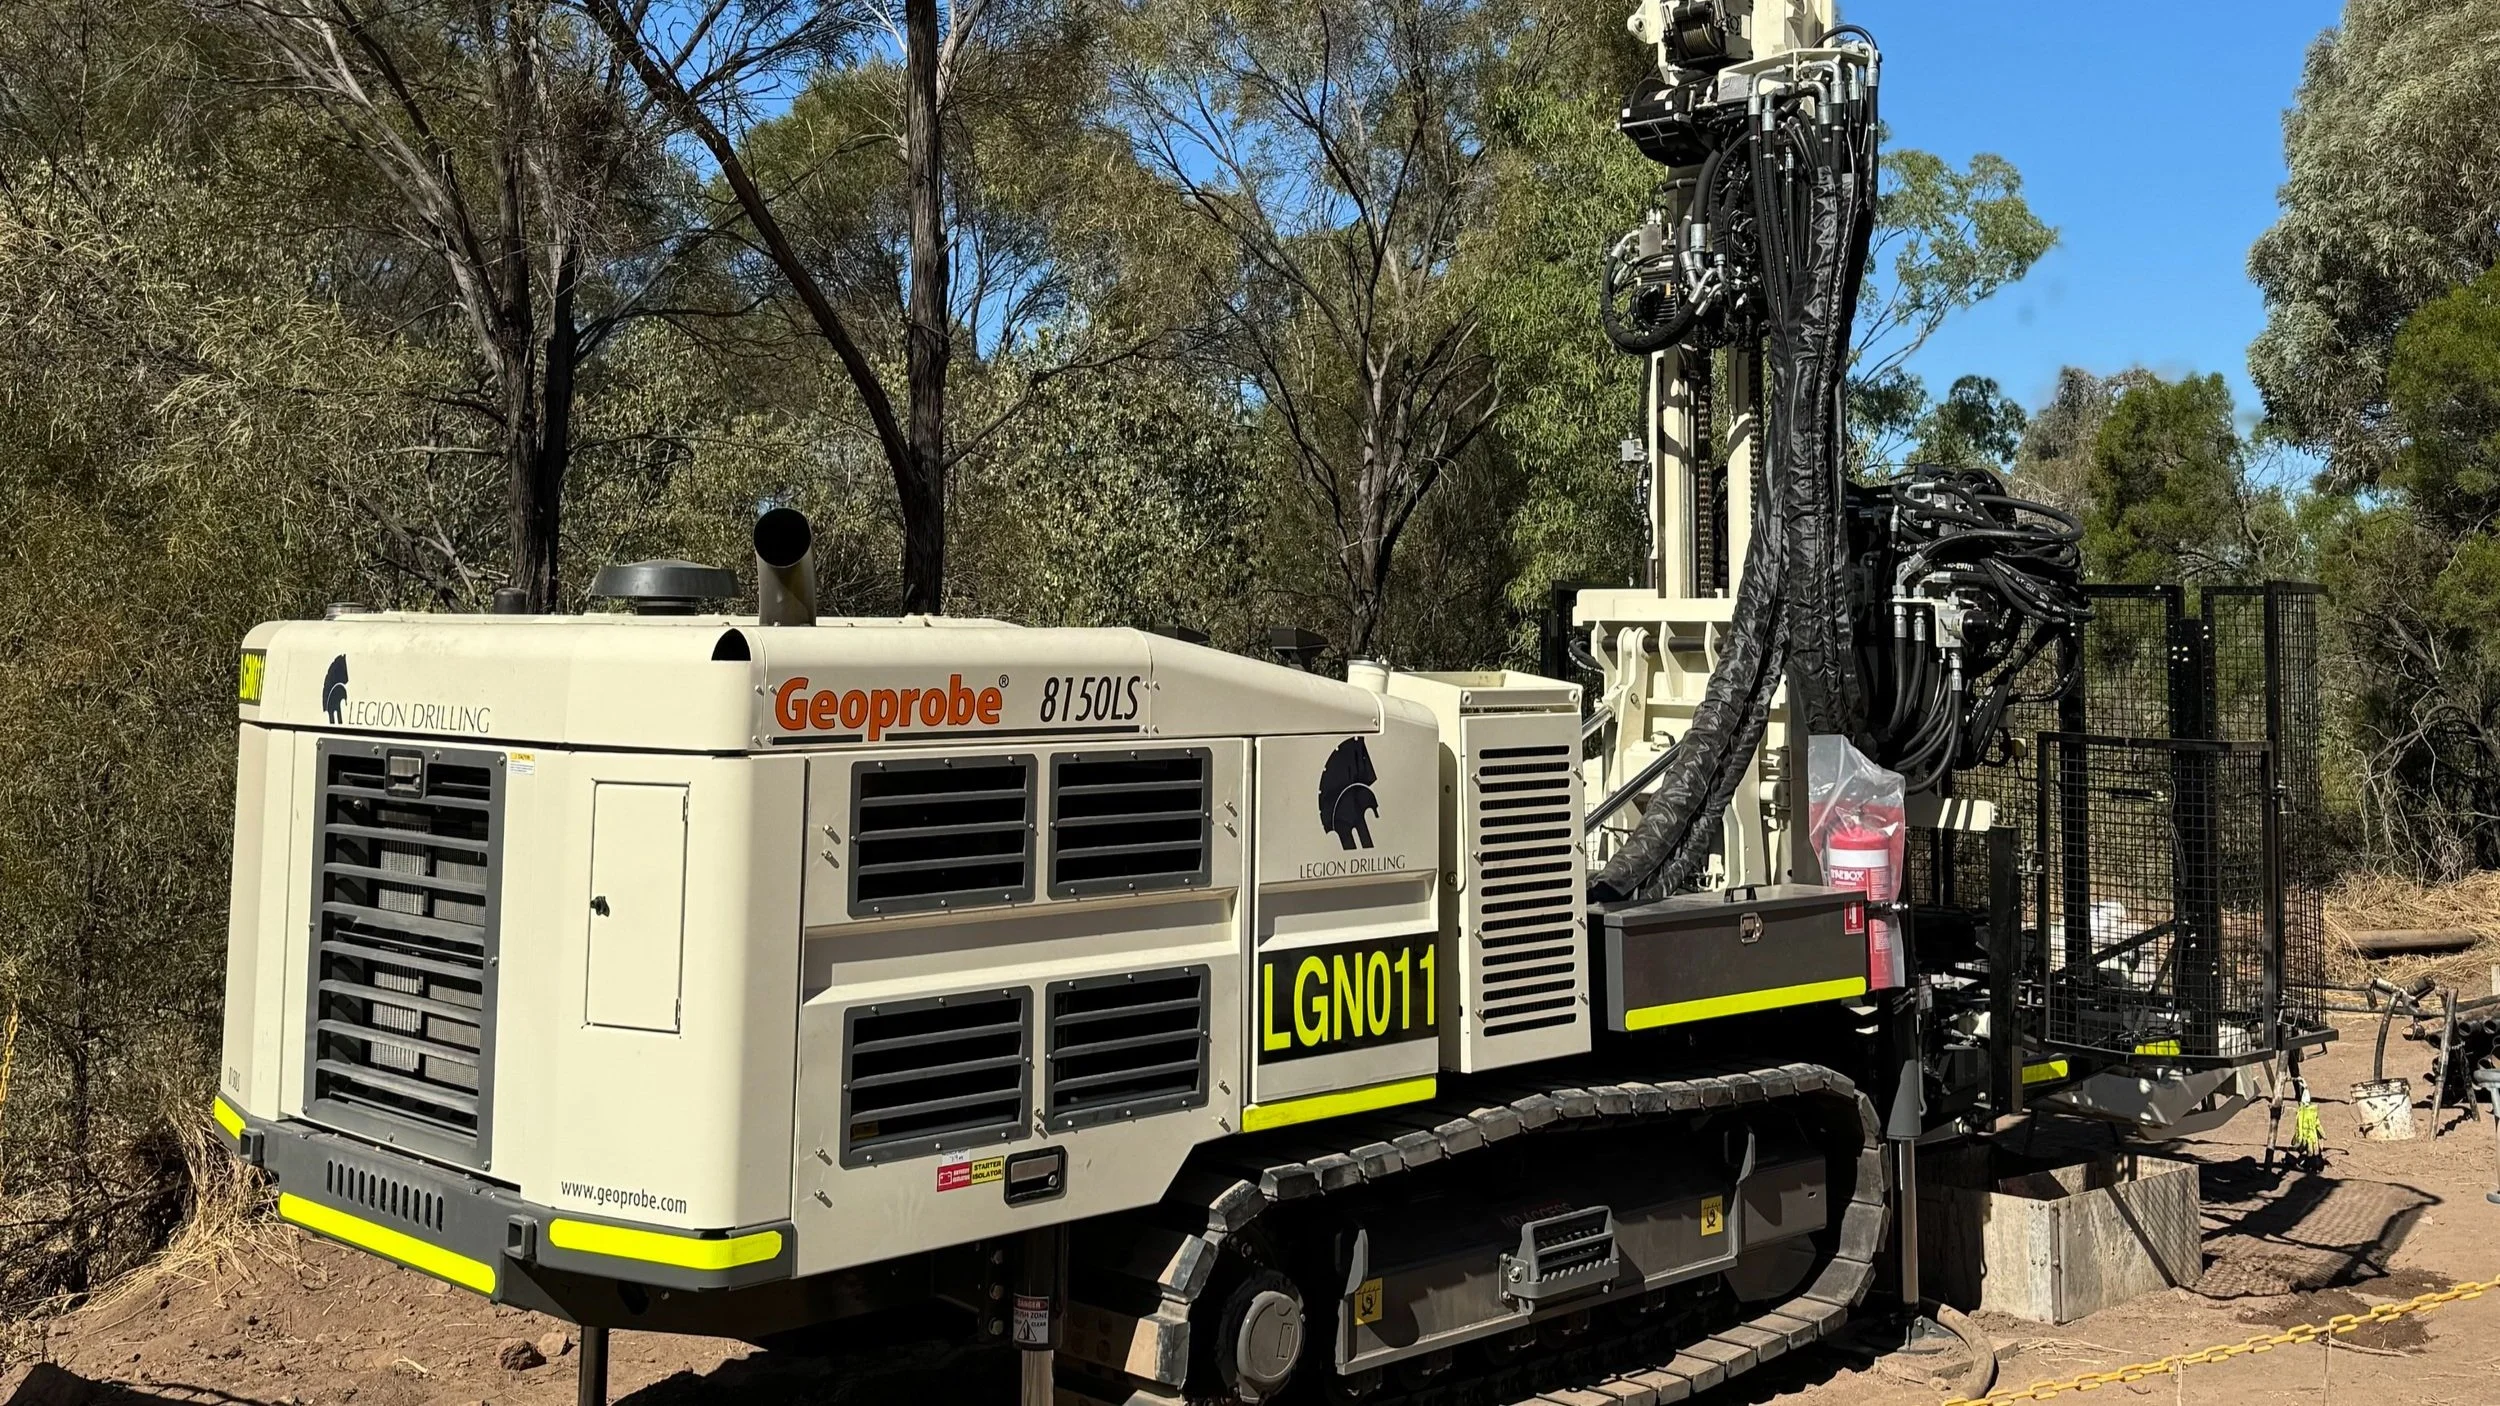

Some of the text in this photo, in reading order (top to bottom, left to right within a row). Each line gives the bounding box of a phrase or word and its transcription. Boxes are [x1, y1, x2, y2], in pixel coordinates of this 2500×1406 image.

[1040, 676, 1140, 722] 8150LS
[348, 701, 491, 733] LEGION DRILLING
[1299, 854, 1406, 879] LEGION DRILLING
[1264, 944, 1435, 1052] LGN011
[972, 1168, 1002, 1180] ISOLATOR
[974, 1160, 1002, 1171] STARTER
[561, 1181, 687, 1214] www.geoprobe.com
